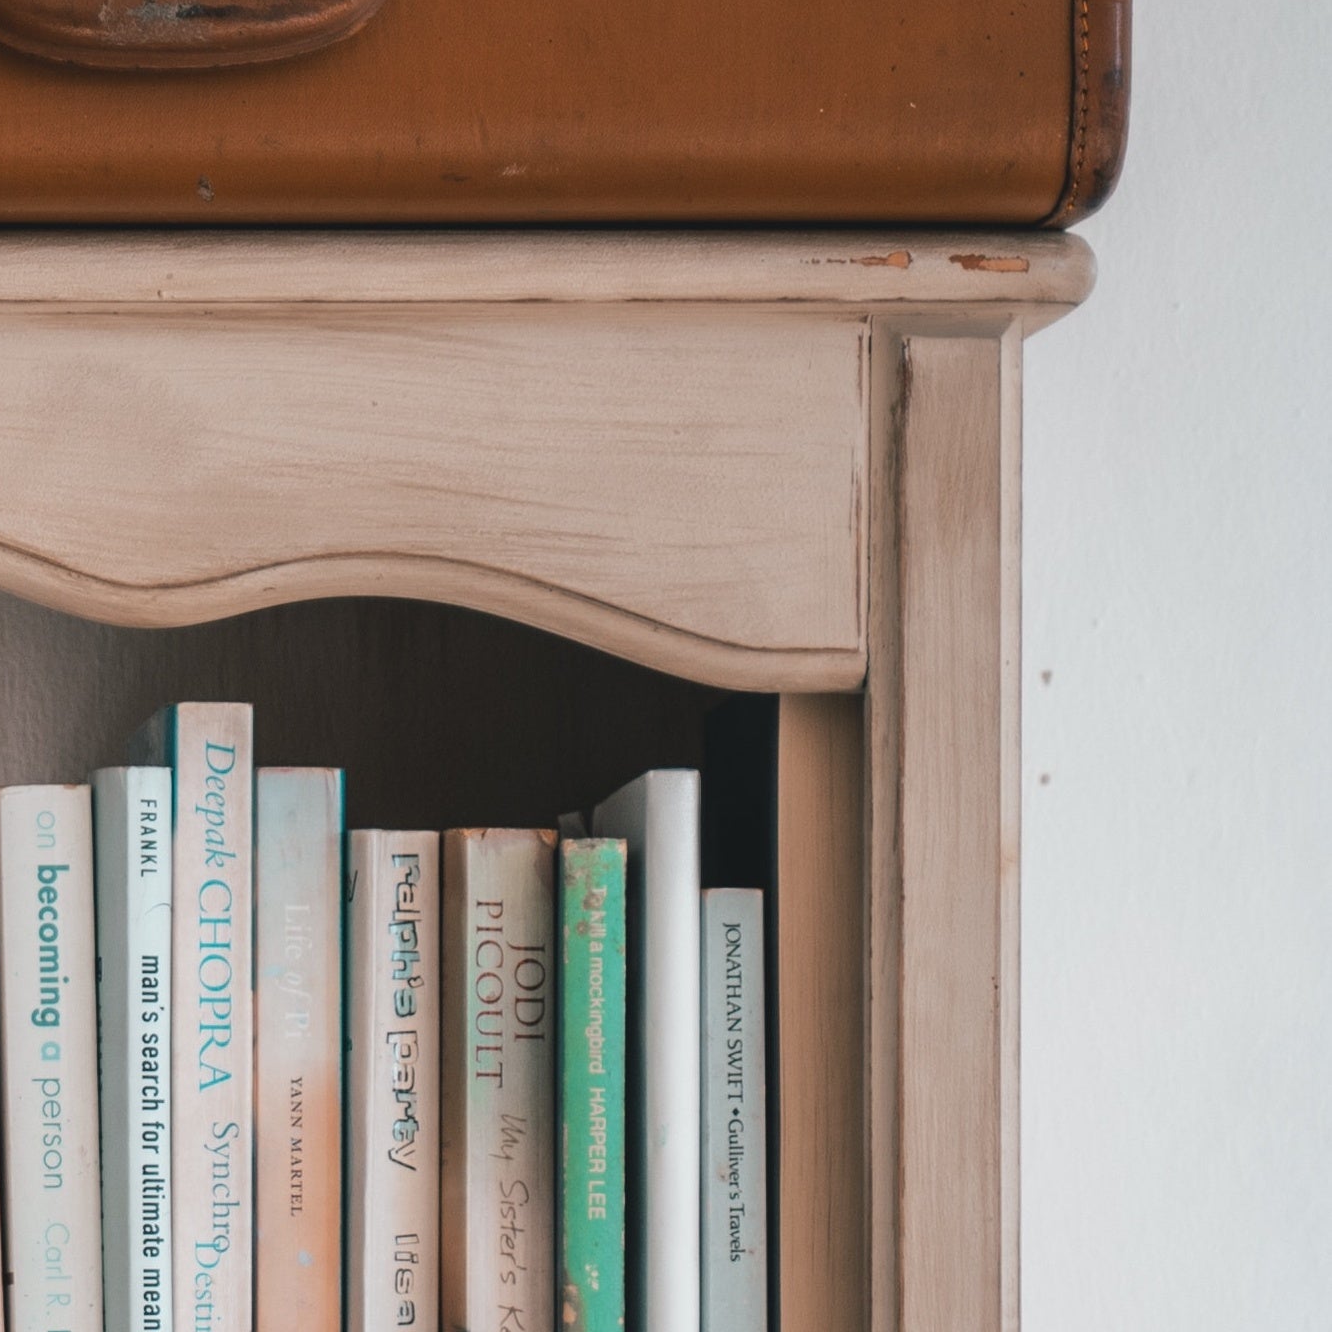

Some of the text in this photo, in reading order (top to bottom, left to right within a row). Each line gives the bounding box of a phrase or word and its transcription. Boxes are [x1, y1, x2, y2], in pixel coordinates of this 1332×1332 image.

[140, 798, 157, 877] FRANKL
[32, 864, 69, 1027] becoming
[195, 741, 235, 1092] Deepak CHOPRA
[588, 909, 607, 937] kill
[590, 942, 603, 952] a
[140, 955, 166, 1022] man's
[585, 957, 607, 1075] mockingbird
[40, 1041, 66, 1062] a
[141, 1033, 167, 1110] search
[589, 1088, 604, 1172] HARPER
[723, 923, 747, 1262] JONATHAN SWIFT Gulliver's Travels
[33, 1077, 68, 1190] person
[141, 1121, 165, 1154] for
[290, 1076, 304, 1217] YANN MARTEL
[142, 1163, 168, 1257] ultimate
[589, 1180, 606, 1220] LEE
